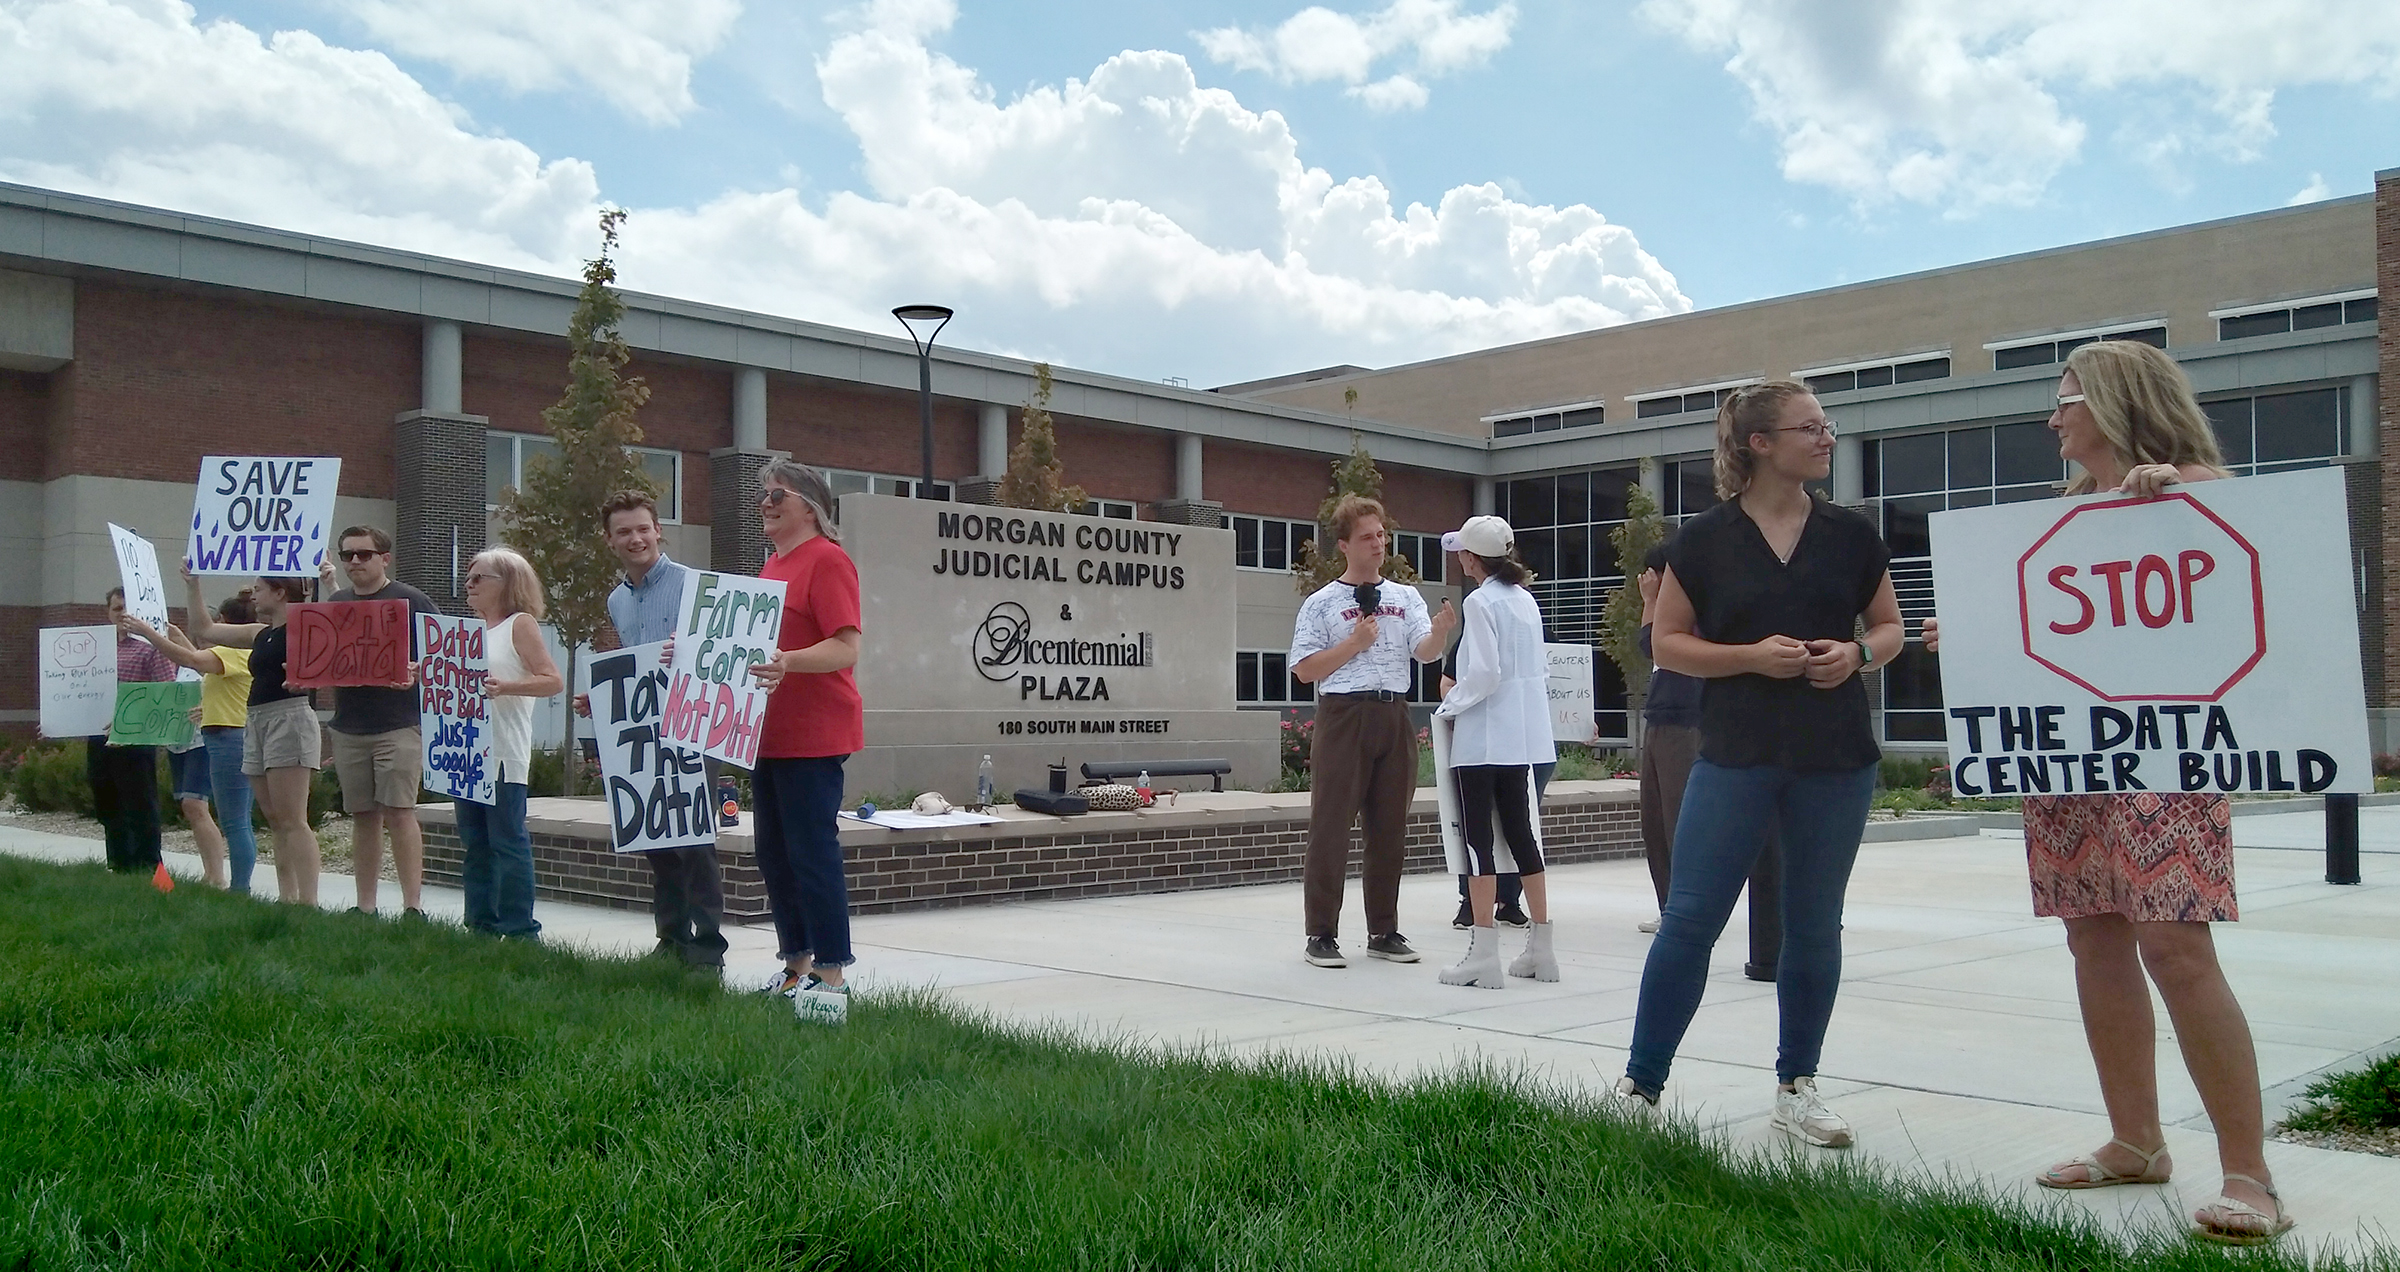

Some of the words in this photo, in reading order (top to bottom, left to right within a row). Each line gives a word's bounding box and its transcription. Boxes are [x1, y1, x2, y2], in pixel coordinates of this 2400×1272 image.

[215, 460, 314, 496] SAVE
[227, 496, 293, 532] OUR
[938, 512, 1065, 547] MORGAN
[1075, 525, 1182, 557] COUNTY
[196, 535, 304, 571] WATER
[932, 549, 1067, 583] JUDICIAL
[1077, 559, 1185, 590] CAMPUS
[687, 572, 781, 641] Farm
[1060, 603, 1072, 621] &
[2047, 549, 2215, 635] STOP
[58, 639, 91, 658] STOP
[296, 609, 396, 681] Data
[423, 615, 483, 659] Data
[973, 601, 1145, 682] Bicentennial
[91, 666, 115, 677] Data
[590, 653, 669, 725] Ta
[1021, 675, 1110, 701] PLAZA
[114, 686, 193, 742] Corn
[422, 687, 453, 716] Are
[456, 689, 489, 724] Bad,
[659, 667, 711, 744] Not
[705, 682, 764, 766] Data
[1576, 689, 1591, 700] US
[434, 714, 479, 748] Just
[998, 721, 1022, 735] 180
[1027, 720, 1076, 734] SOUTH
[1080, 720, 1115, 734] MAIN
[1119, 720, 1170, 734] STREET
[1950, 705, 2065, 754] THE
[2090, 704, 2240, 751] DATA
[428, 742, 484, 788] Google
[616, 722, 703, 778] The
[1954, 751, 2148, 796] CENTER
[2179, 748, 2338, 793] BUILD
[609, 774, 712, 848] Data
[801, 994, 839, 1013] Please
